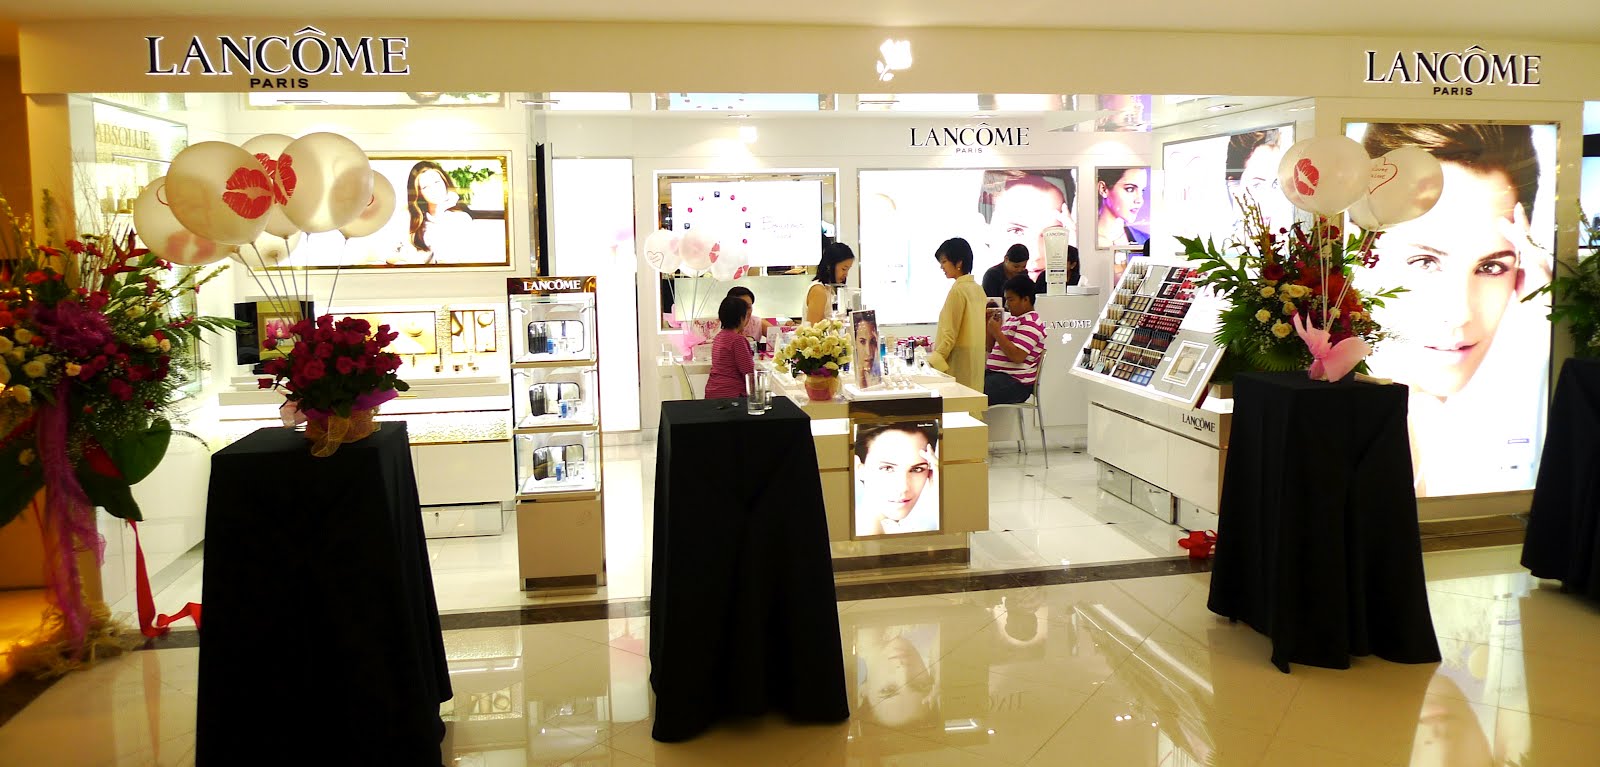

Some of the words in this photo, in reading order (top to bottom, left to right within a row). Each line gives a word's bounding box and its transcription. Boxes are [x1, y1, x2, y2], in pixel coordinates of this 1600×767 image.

[145, 26, 410, 76] LANCÔME
[1363, 45, 1542, 87] LANCÔME
[249, 78, 310, 89] PARIS
[1433, 86, 1474, 96] PARIS
[910, 122, 1030, 147] LANCÔME
[523, 278, 581, 291] LANCÔME
